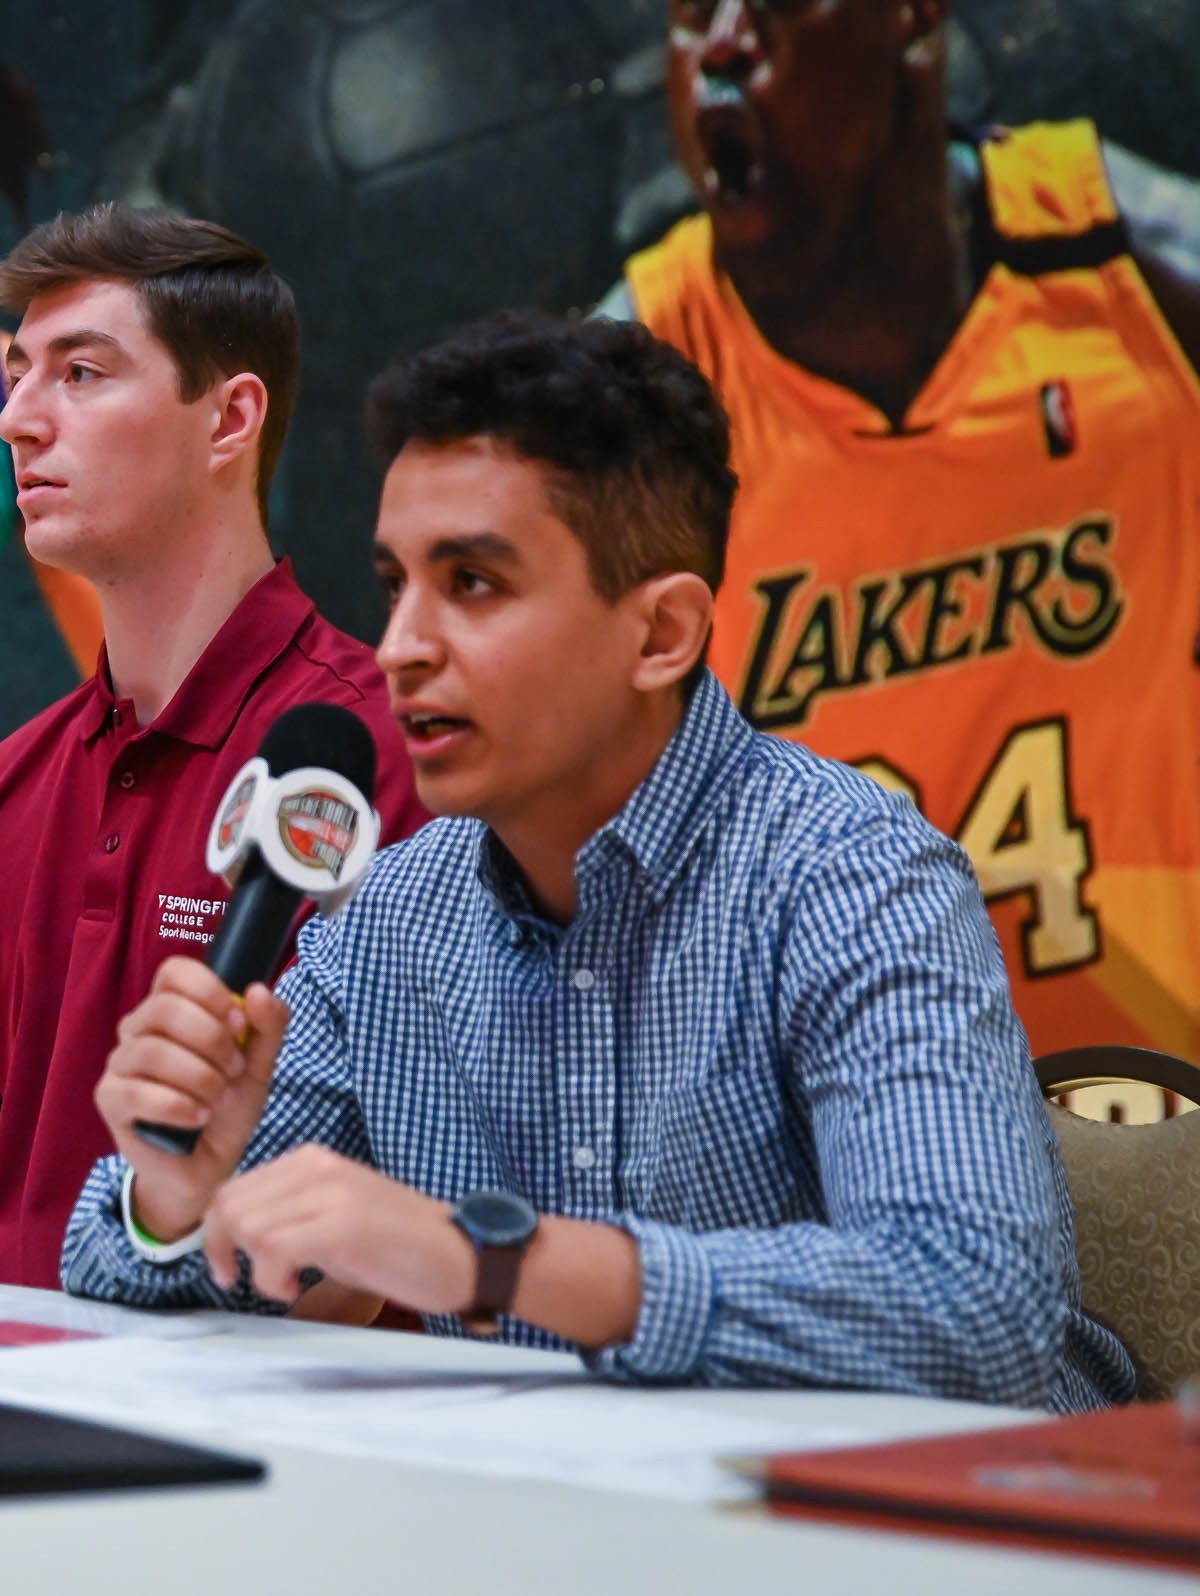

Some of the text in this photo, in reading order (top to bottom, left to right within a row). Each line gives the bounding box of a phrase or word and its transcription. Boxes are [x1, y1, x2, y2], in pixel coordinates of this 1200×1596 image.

[737, 510, 1125, 729] LAKERS
[165, 895, 229, 915] SPRINGFI
[162, 912, 205, 927] COLLEGE
[158, 925, 179, 938] Sport
